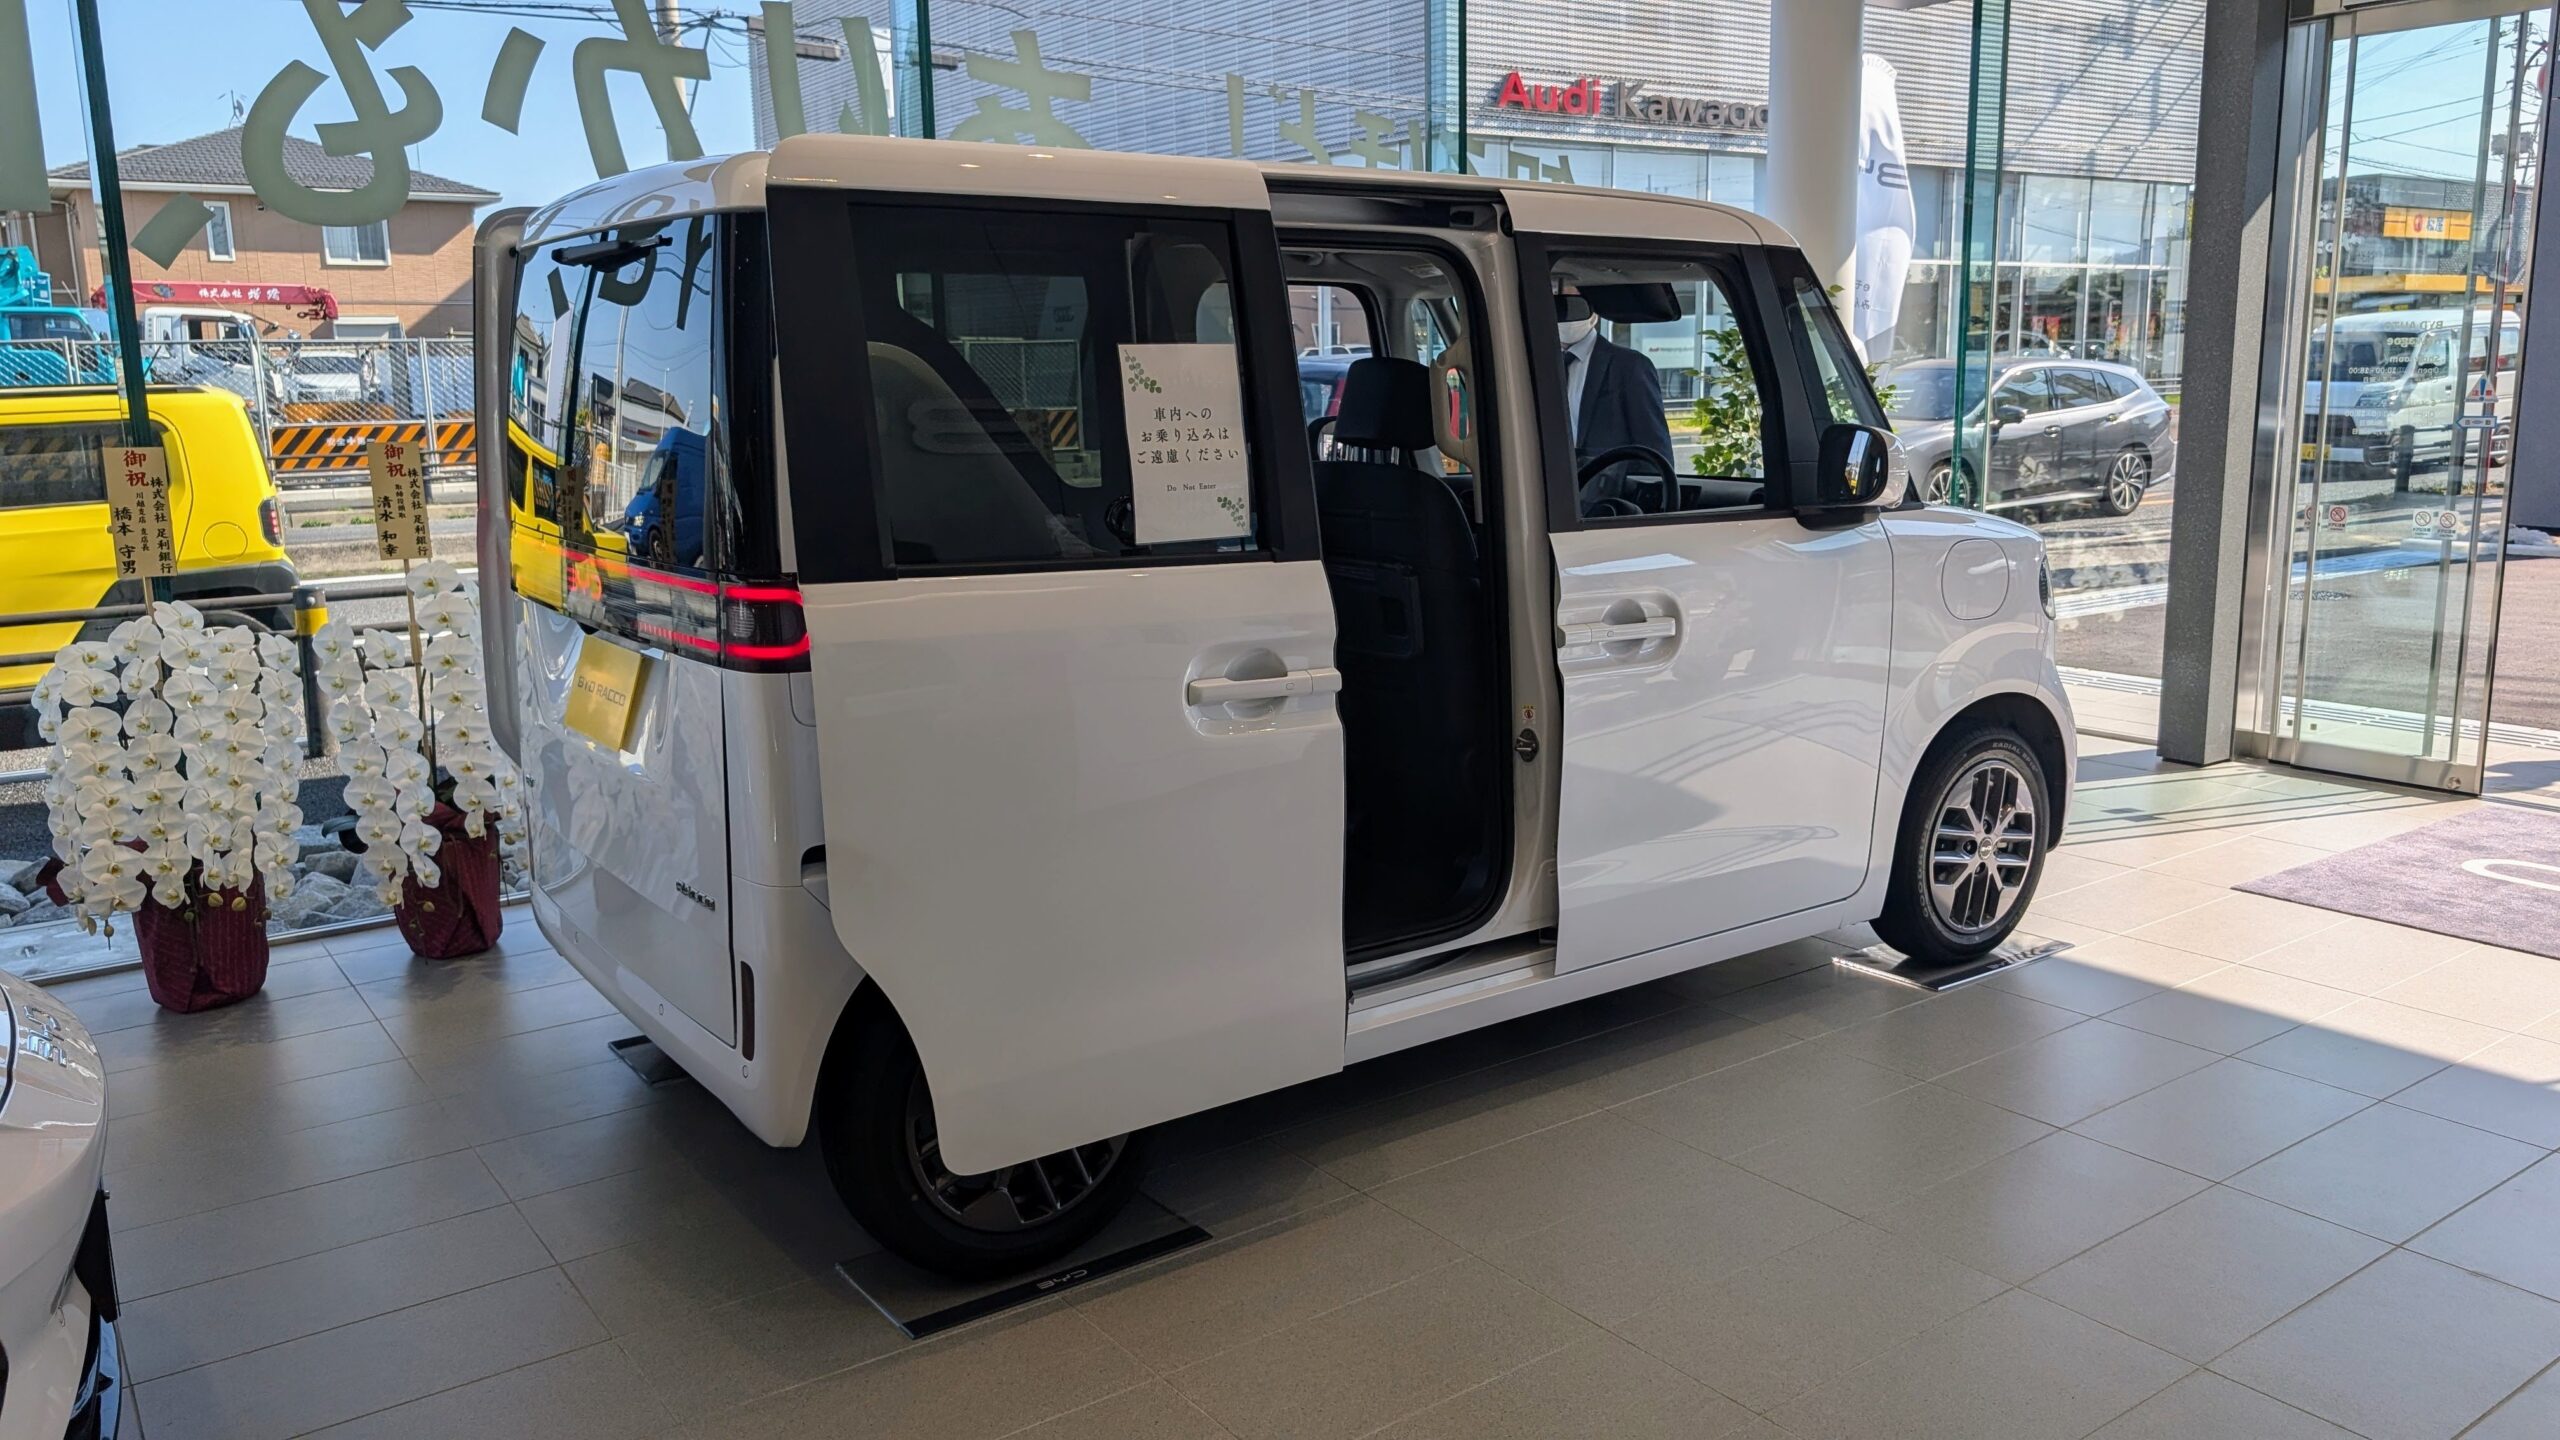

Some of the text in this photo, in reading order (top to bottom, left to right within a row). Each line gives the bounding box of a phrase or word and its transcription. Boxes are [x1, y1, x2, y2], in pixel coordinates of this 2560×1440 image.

[1497, 71, 1600, 116] Audi
[198, 287, 243, 298] 株式会社
[1154, 406, 1212, 421] 車内への
[1142, 427, 1229, 443] お乗り込みは
[123, 450, 149, 487] 御祝
[384, 444, 407, 477] 御祝
[1137, 448, 1239, 464] ご遠慮ください
[114, 506, 135, 536] 橋本
[150, 477, 173, 574] 株式会社 足利銀行
[408, 467, 429, 556] 株式会社 足利銀行
[577, 676, 627, 707] BYD RACCO
